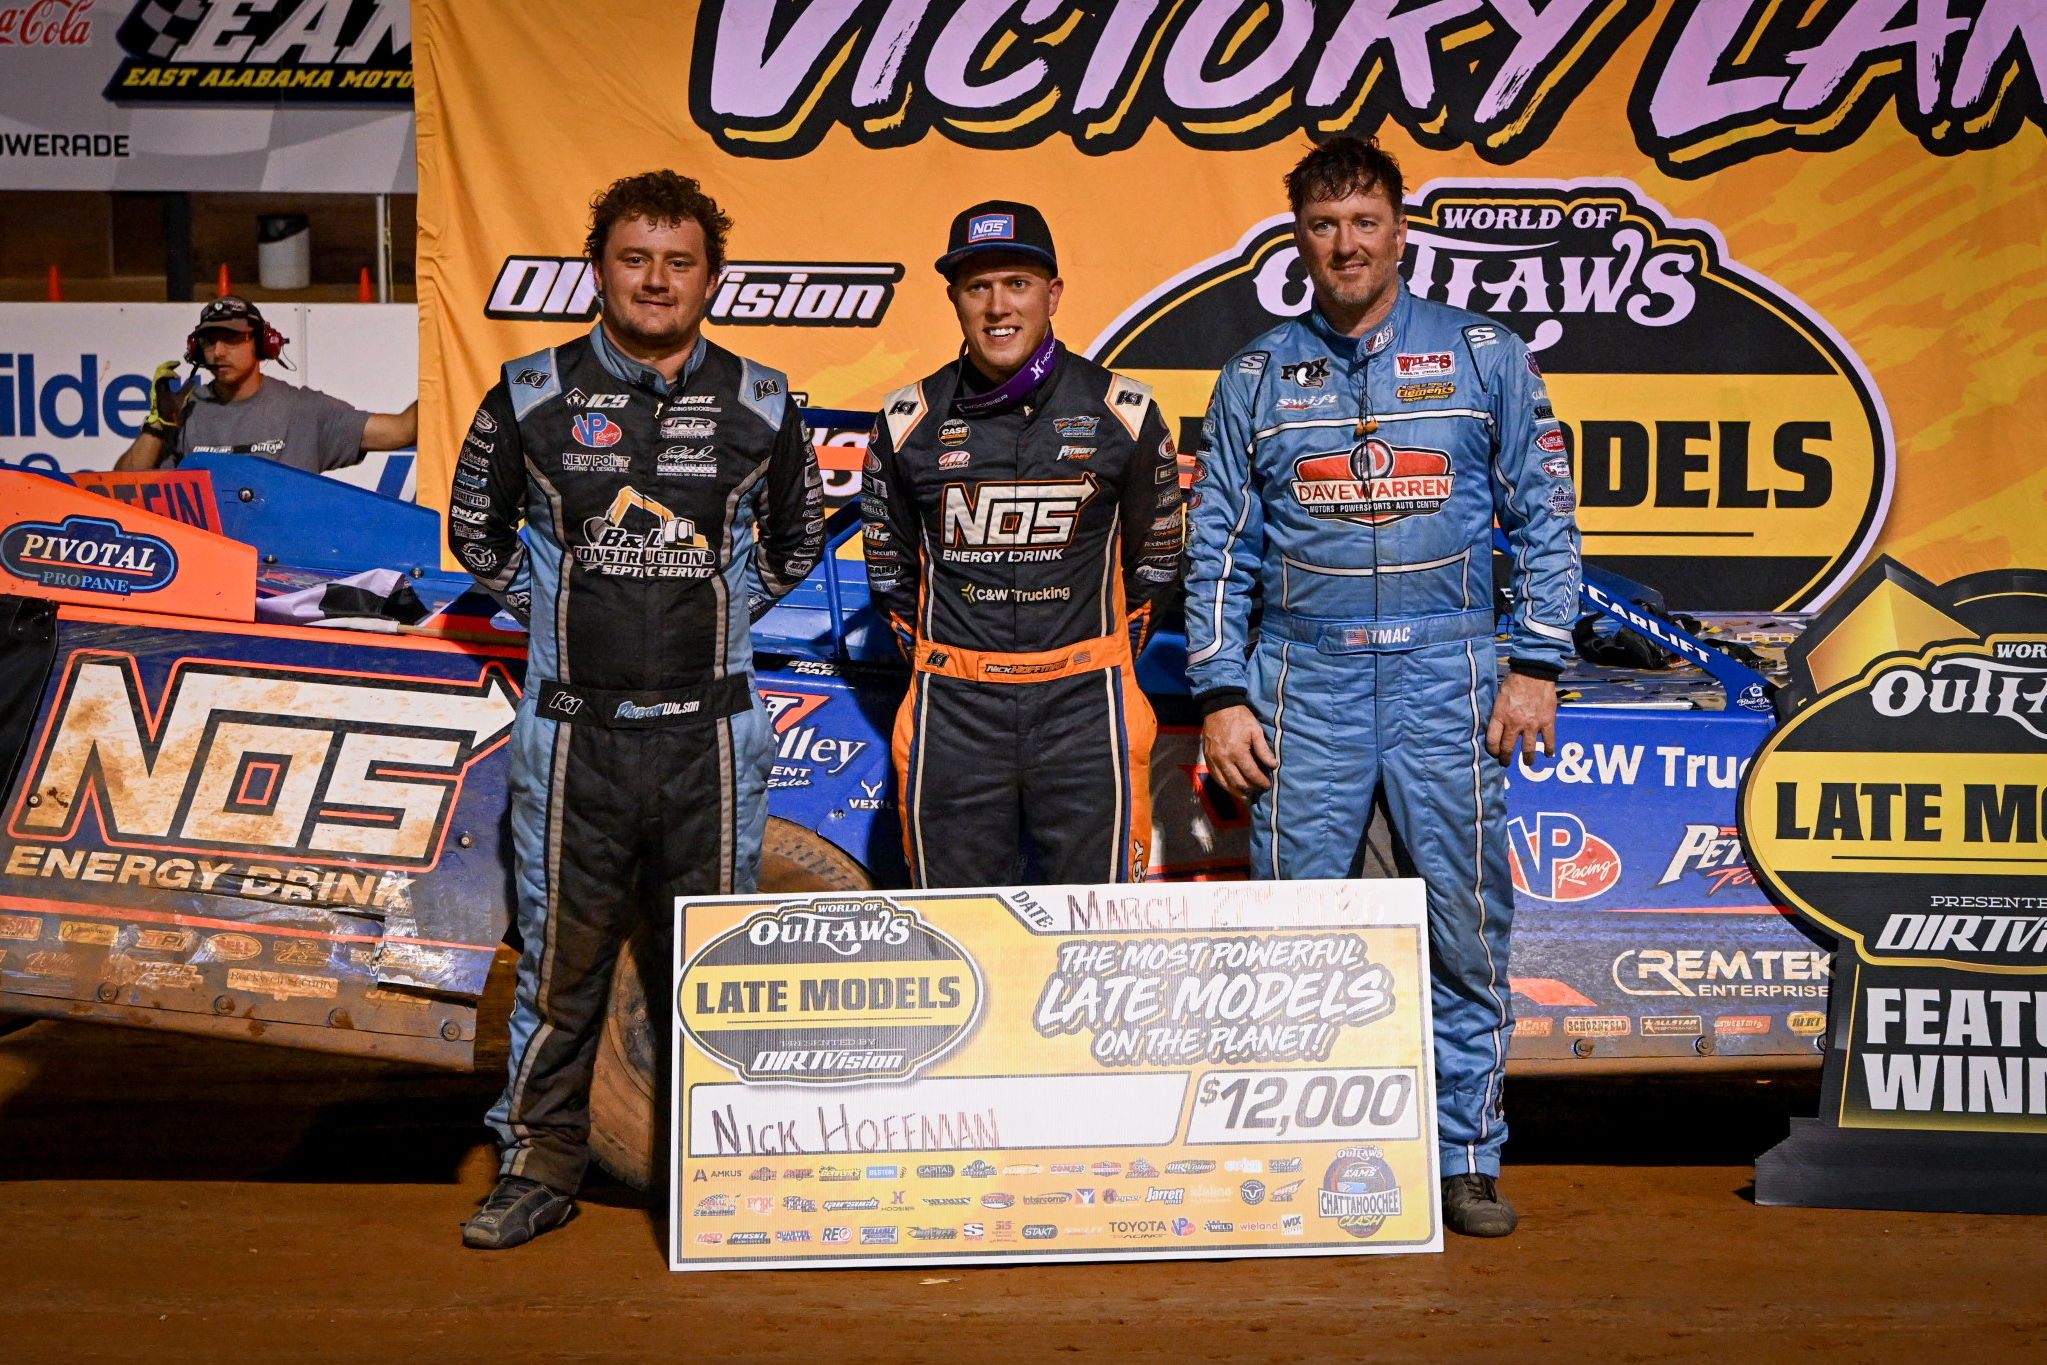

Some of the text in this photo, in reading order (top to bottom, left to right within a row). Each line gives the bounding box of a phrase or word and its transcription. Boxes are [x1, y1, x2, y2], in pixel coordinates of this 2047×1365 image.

[122, 68, 200, 87] EAST
[199, 68, 332, 88] ALABAMA
[0, 133, 130, 157] WERADE
[973, 219, 1008, 236] NOS
[1443, 206, 1620, 229] WORLD OF
[514, 369, 551, 389] K1
[1281, 357, 1331, 388] FOX
[753, 379, 781, 400] K1
[1115, 391, 1145, 405] K1
[585, 394, 631, 408] ICS
[888, 400, 920, 415] K1
[573, 412, 608, 448] VP
[662, 419, 711, 428] JRR
[941, 427, 969, 435] CASE
[562, 453, 592, 466] NEW
[1561, 421, 1834, 509] DELS
[945, 478, 1095, 545] NOS
[1309, 499, 1440, 514] MOTORS POWERSPORTS AUTO CENTER
[599, 527, 662, 549] B&L
[19, 533, 157, 572] PIVOTAL
[872, 549, 898, 557] Security
[942, 548, 1064, 563] ENERGY DRINK
[42, 570, 130, 594] PROPANE
[976, 586, 1071, 602] C&W Trucking
[1588, 584, 1711, 664] CARLIFT
[1371, 626, 1411, 643] TMAC
[926, 650, 950, 668] K1
[549, 691, 584, 715] K1
[772, 726, 867, 774] lley
[20, 662, 518, 860] NOS
[1518, 742, 1752, 788] C&W Tru
[767, 778, 812, 788] Sales
[1775, 781, 1943, 842] LATE
[1506, 811, 1587, 899] VP
[4, 845, 417, 908] ENERGY DRINK
[1557, 860, 1619, 888] Racing
[817, 901, 882, 914] WORLD OF
[1011, 890, 1055, 930] DATE:
[1067, 890, 1189, 931] MARCH
[1062, 938, 1361, 972] THE MOST POWERFUL
[695, 975, 961, 1014] LATE MODELS
[1039, 968, 1385, 1027] LATE MODELS
[1567, 1021, 1628, 1032] SCHOENFELD
[1652, 1019, 1698, 1027] ALLSTAR
[1792, 1017, 1823, 1028] BERT
[780, 1038, 877, 1048] PRESENTED BY
[1095, 1022, 1329, 1058] ON THE PLANET!
[1199, 1074, 1412, 1137] $12,000
[815, 1102, 1002, 1152] HOFFMAN
[710, 1169, 743, 1178] AMKUS
[918, 1166, 952, 1174] CAPITAL
[1343, 1168, 1377, 1178] EAMS
[1146, 1187, 1185, 1203] Jarrett
[1321, 1188, 1400, 1214] CHATTAHOOCHEE
[1109, 1221, 1167, 1233] TOYOTA
[1171, 1217, 1188, 1237] VP
[1239, 1222, 1278, 1231] wieland
[1282, 1216, 1302, 1227] WIX
[1338, 1215, 1384, 1227] CLASH
